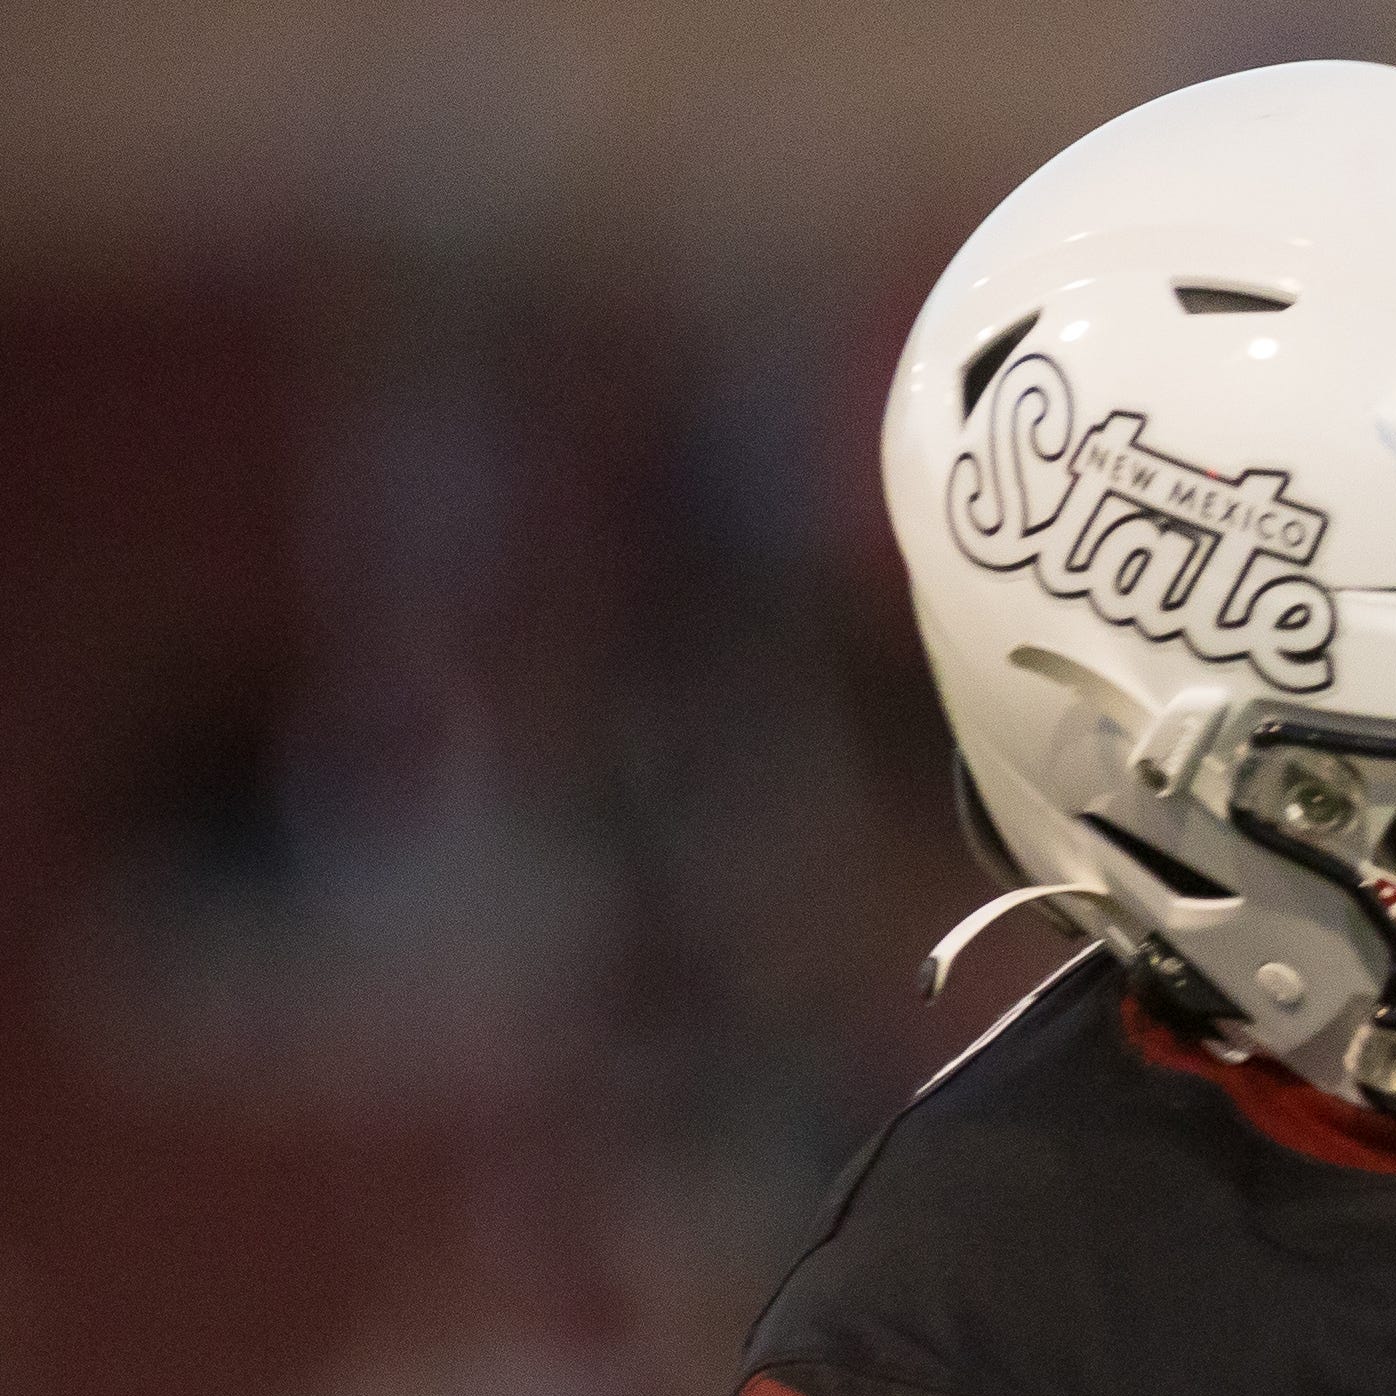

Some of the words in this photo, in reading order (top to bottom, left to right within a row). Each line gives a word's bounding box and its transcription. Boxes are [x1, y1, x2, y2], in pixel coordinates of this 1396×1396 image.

[945, 352, 1337, 692] State
[1087, 445, 1158, 490] NEW
[1169, 480, 1305, 548] MEXICO
